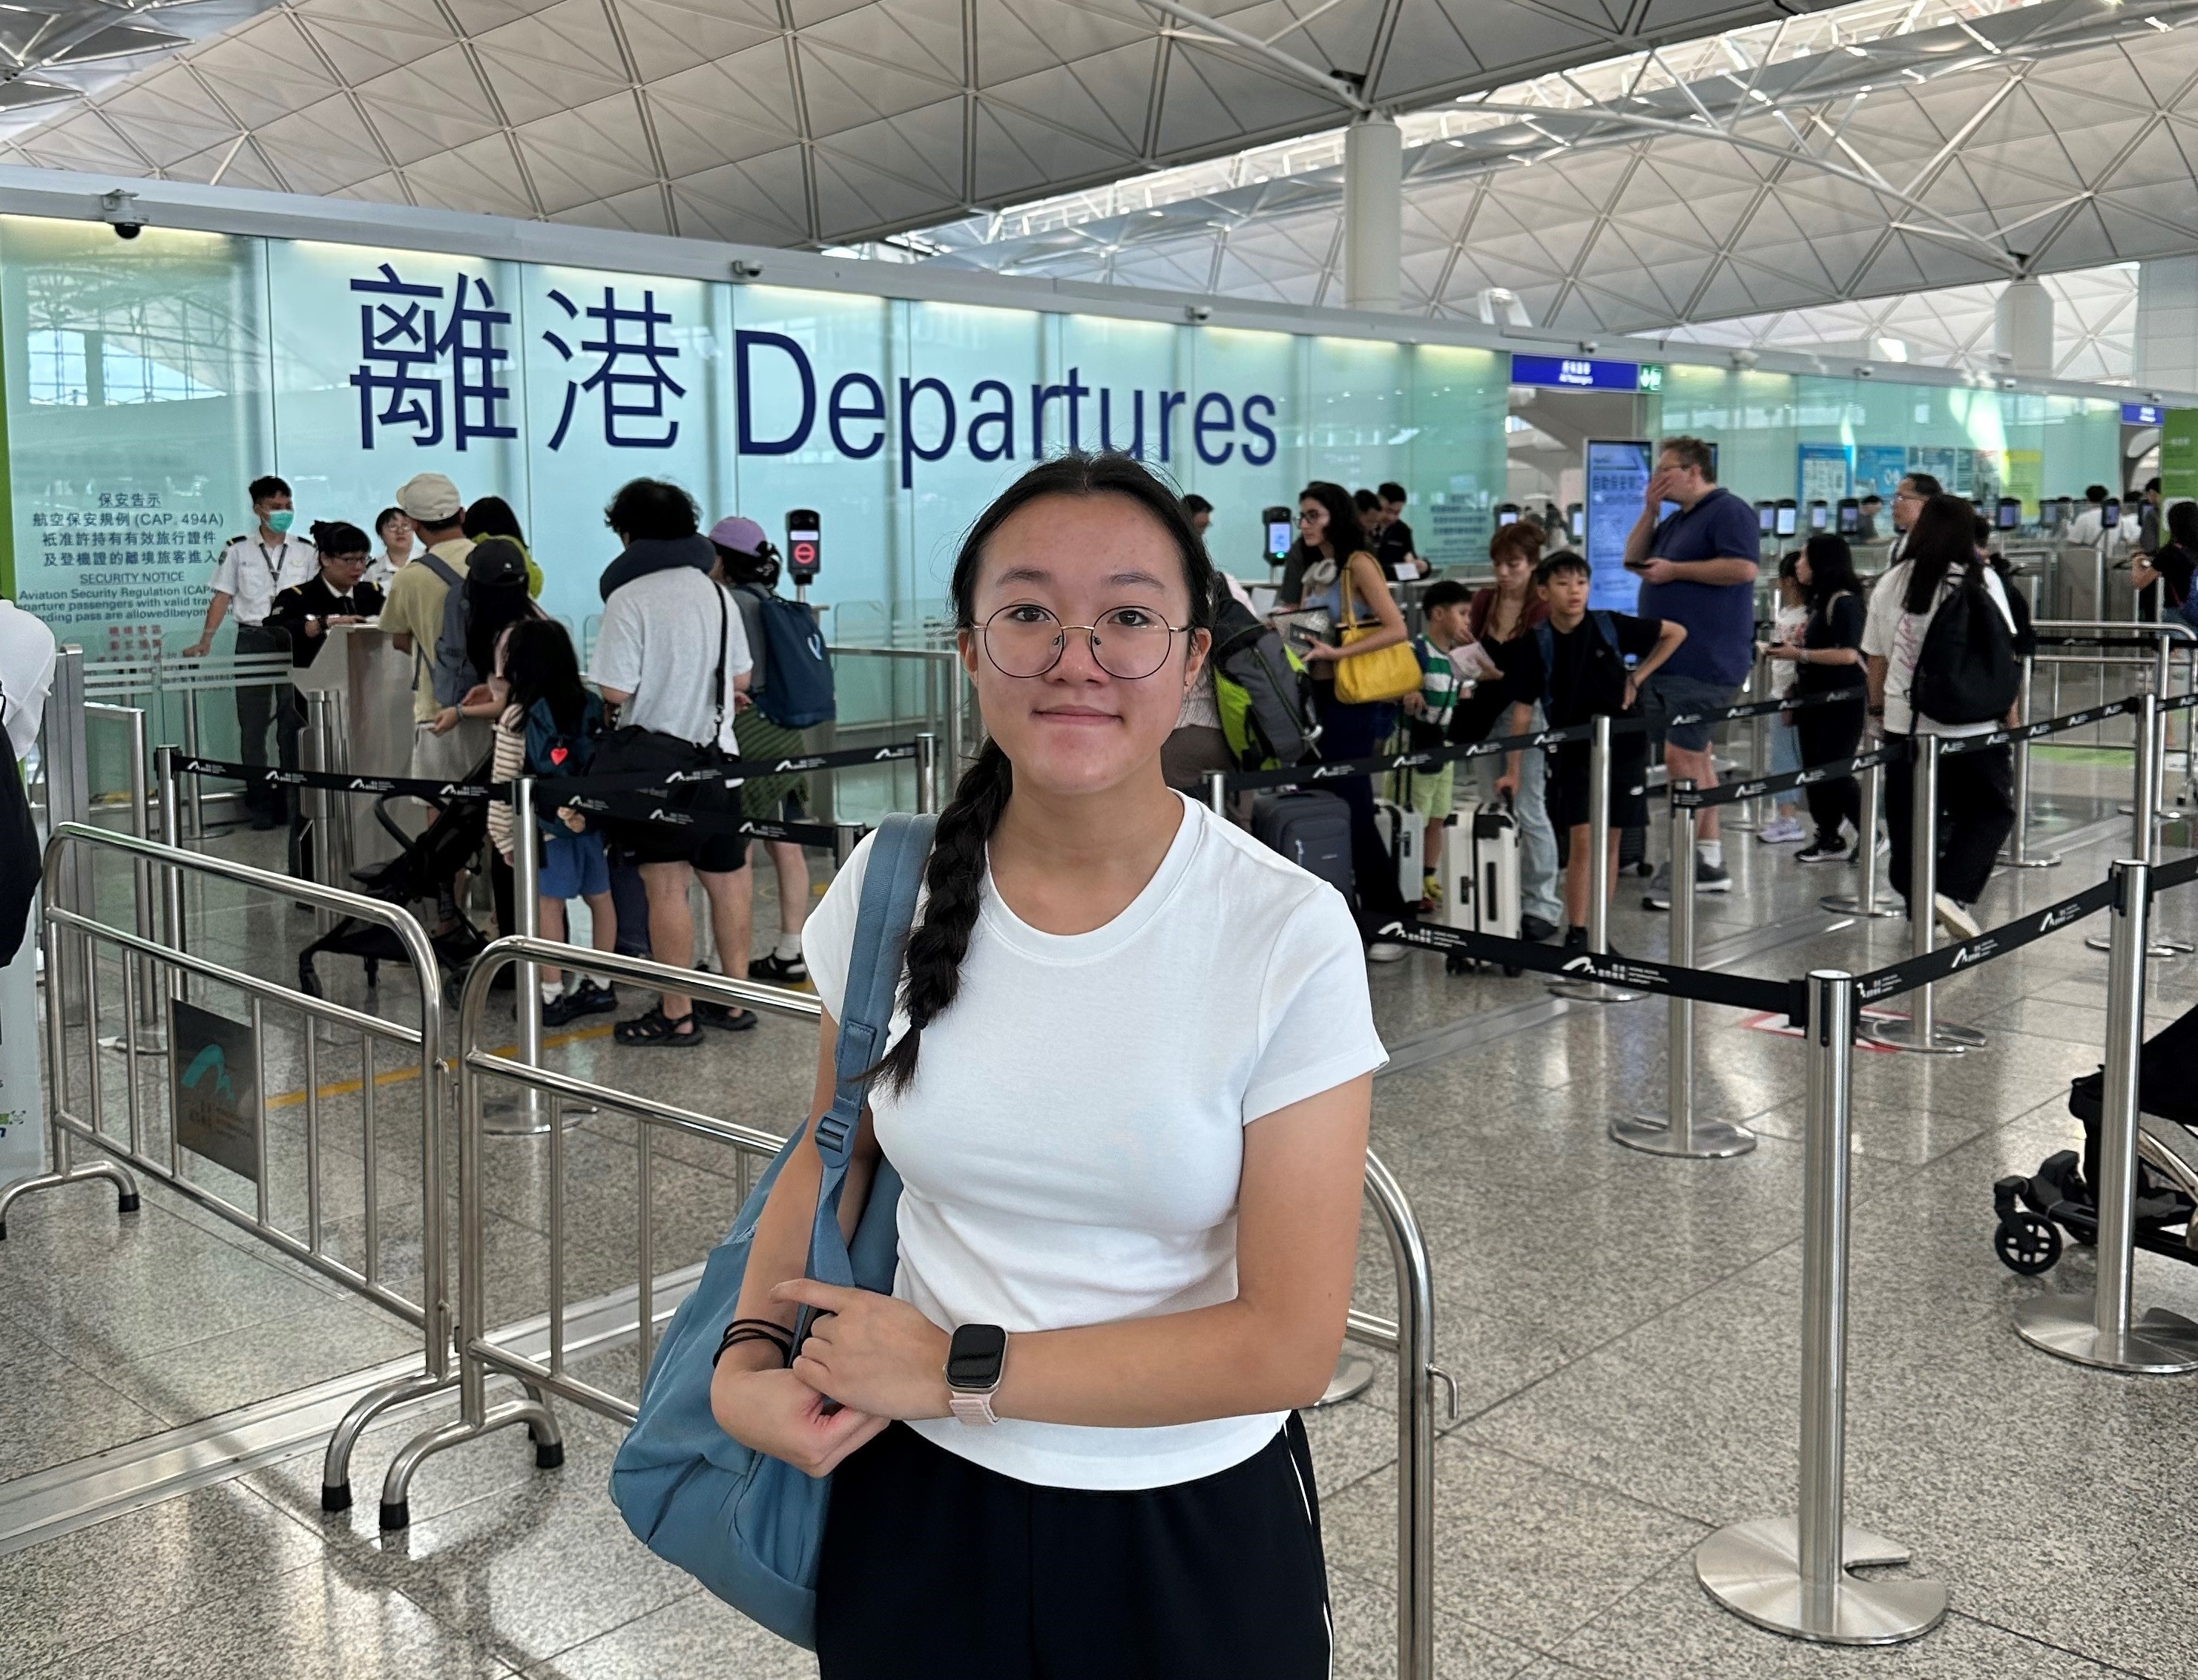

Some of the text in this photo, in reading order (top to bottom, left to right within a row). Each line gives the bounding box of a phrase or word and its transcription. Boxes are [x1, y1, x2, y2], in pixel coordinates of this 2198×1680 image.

[349, 263, 1278, 488] 離港 Departures
[99, 493, 161, 507] 保安告示
[182, 513, 224, 528] 494A)
[80, 570, 185, 584] SECURITY NOTICE
[19, 590, 68, 600] Aviation
[71, 587, 117, 599] Security
[121, 587, 180, 600] Regulation
[17, 602, 65, 611] parture
[69, 599, 134, 612] passengers
[136, 597, 161, 608] with
[163, 596, 190, 607] valid
[76, 611, 102, 622] pass
[105, 610, 123, 620] are
[173, 607, 206, 619] beyon
